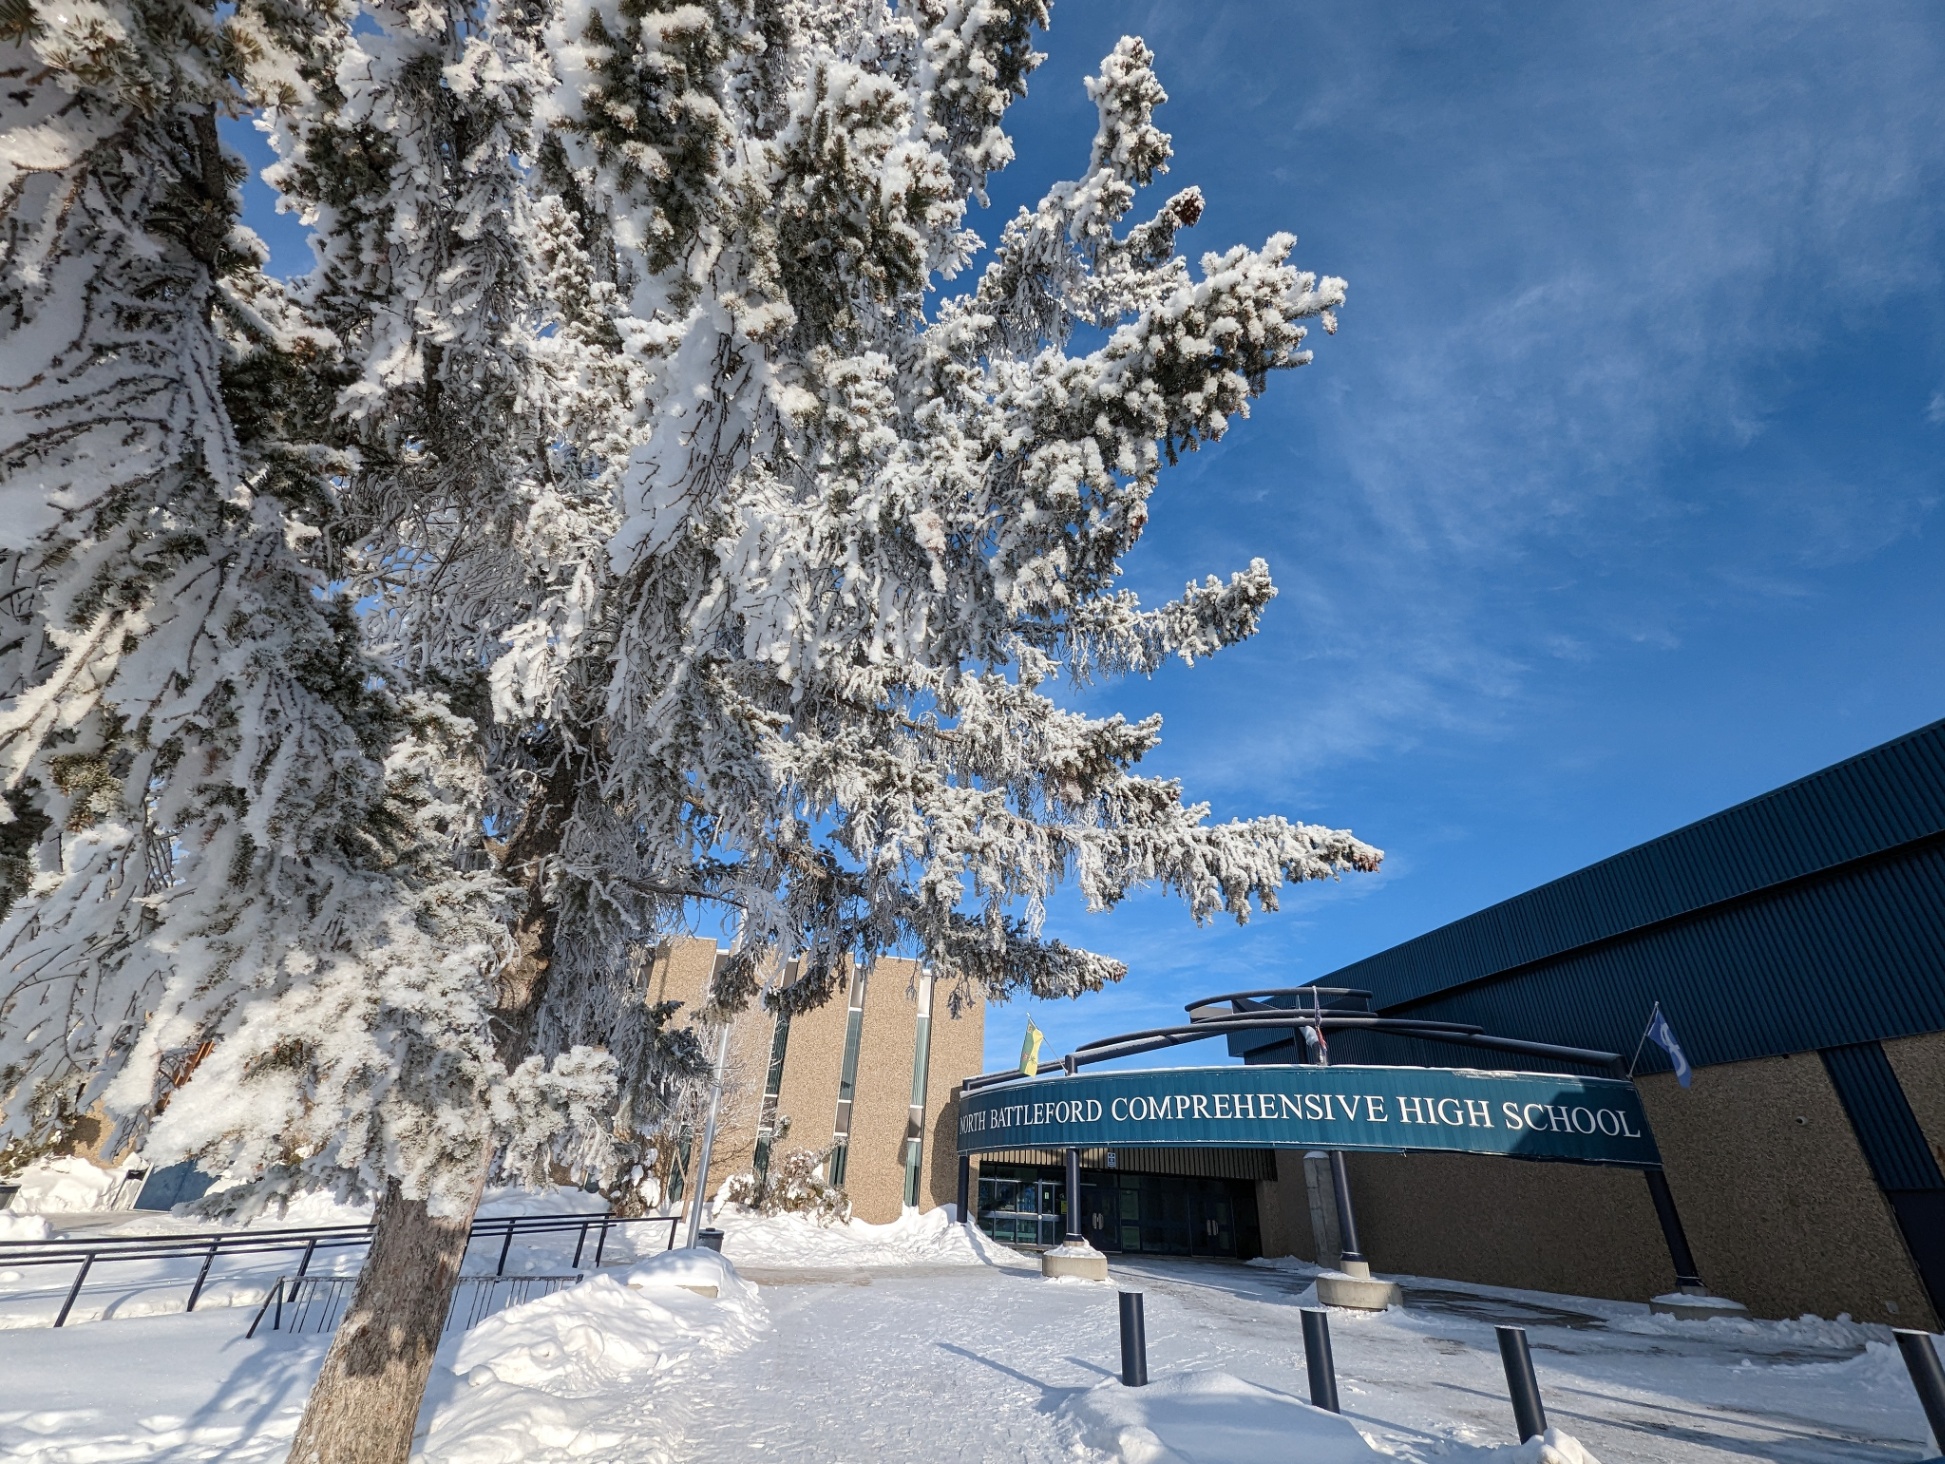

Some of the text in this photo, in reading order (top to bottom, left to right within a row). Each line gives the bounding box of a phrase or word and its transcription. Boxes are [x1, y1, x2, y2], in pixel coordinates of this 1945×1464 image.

[959, 1093, 1641, 1138] NORTH BATTLEFORD COMPREHENSIVE HIGH SCHOOL
